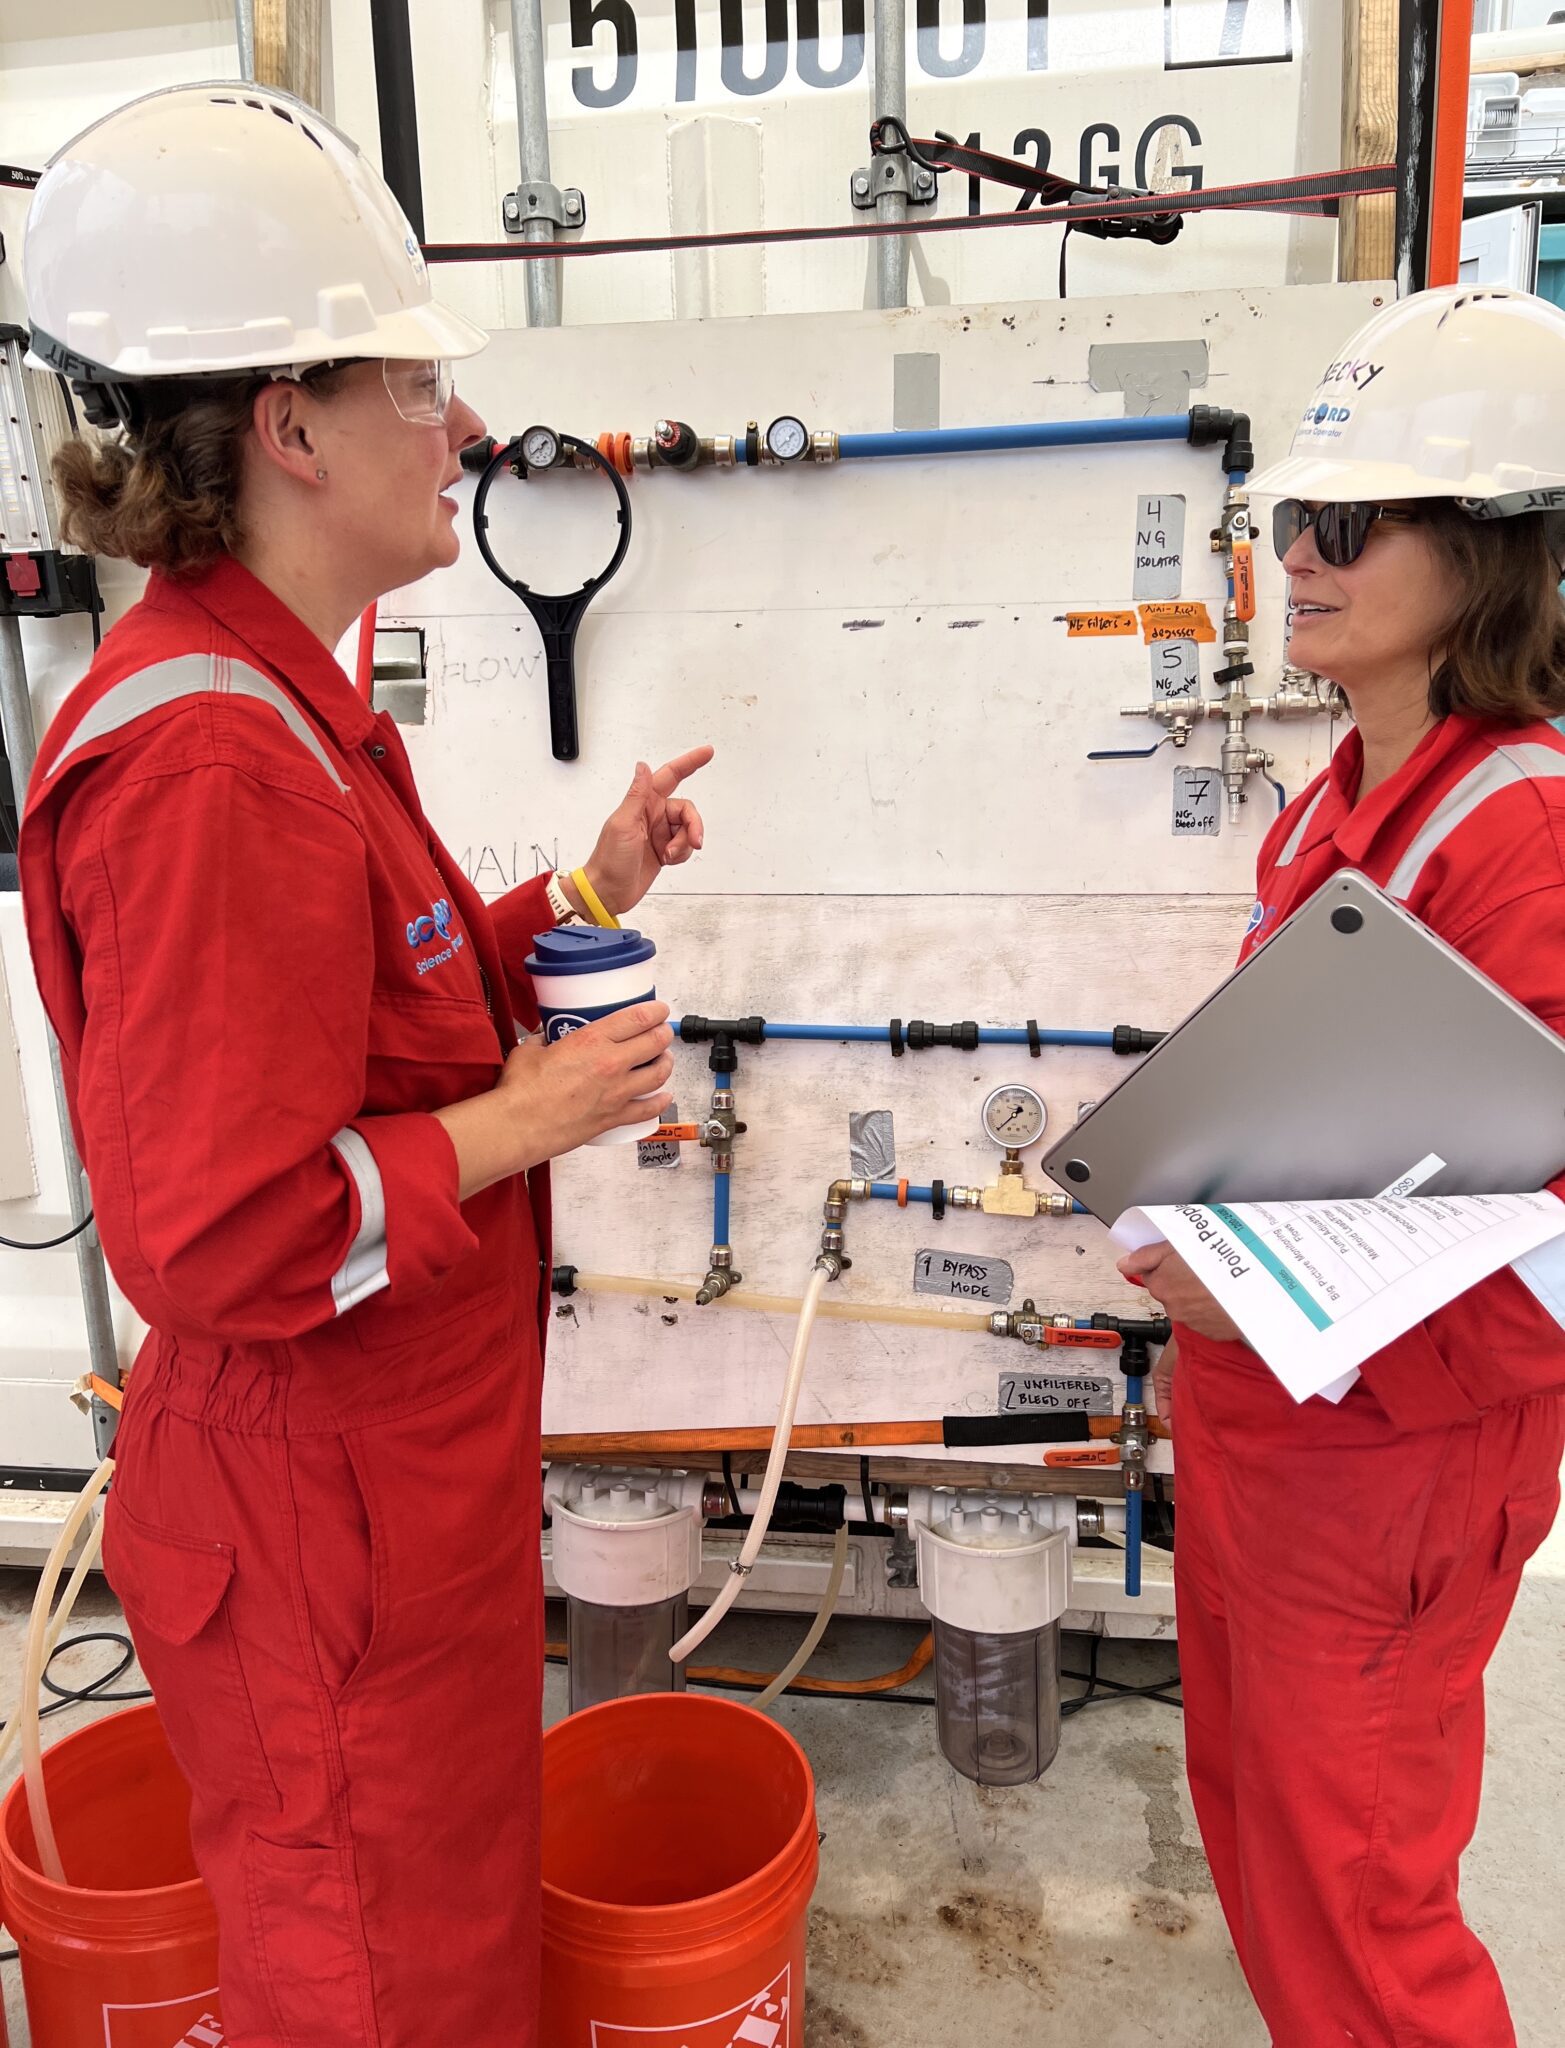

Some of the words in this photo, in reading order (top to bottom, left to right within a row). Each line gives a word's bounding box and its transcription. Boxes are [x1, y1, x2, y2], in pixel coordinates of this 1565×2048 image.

[1147, 500, 1161, 523] 4
[1137, 531, 1165, 546] NG
[1136, 555, 1181, 569] ISOLATOR
[1163, 646, 1181, 668] 5
[442, 650, 542, 687] FLOW
[1156, 677, 1172, 690] NG
[1185, 780, 1210, 805] 7
[1175, 810, 1192, 819] NG
[1197, 816, 1215, 828] off
[416, 948, 452, 975] Science
[1284, 1223, 1303, 1242] Flows
[1305, 1215, 1331, 1235] Adjuster
[1272, 1228, 1305, 1262] Monitoring
[1330, 1235, 1349, 1254] Pump
[1349, 1232, 1379, 1260] Manifold
[924, 1256, 932, 1276] 1
[942, 1259, 988, 1280] BYPASS
[1210, 1238, 1250, 1278] Point
[1279, 1269, 1298, 1290] Roles
[1303, 1260, 1328, 1287] Picture
[951, 1281, 990, 1297] MODE
[1325, 1286, 1340, 1301] Big
[1005, 1381, 1016, 1409] 2
[1024, 1378, 1100, 1392] UNFILTERED
[1018, 1393, 1059, 1407] BLEED
[1067, 1398, 1090, 1409] OFF
